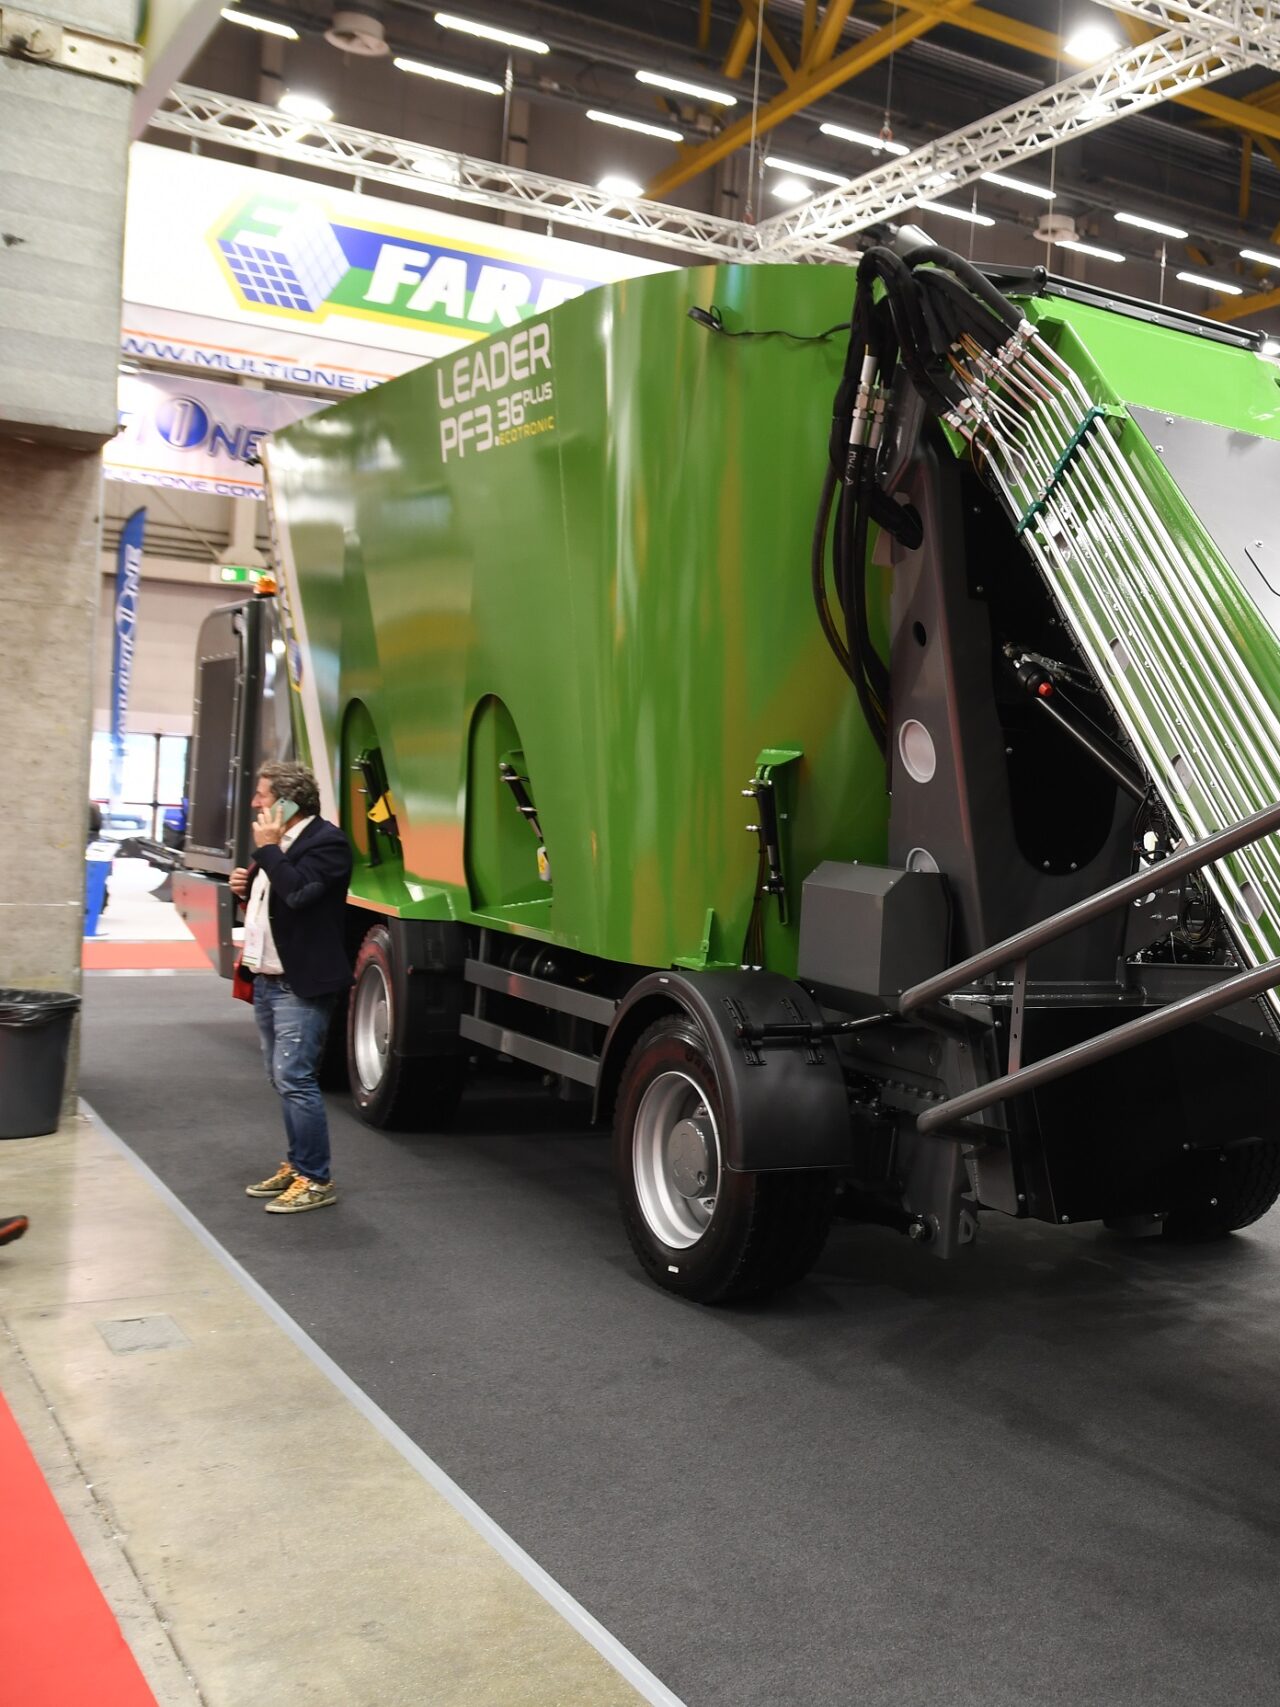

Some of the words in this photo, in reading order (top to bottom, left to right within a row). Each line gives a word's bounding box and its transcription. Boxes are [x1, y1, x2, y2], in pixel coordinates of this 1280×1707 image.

[437, 322, 552, 409] LEADER
[522, 381, 553, 407] PLUS
[499, 415, 555, 446] ECOTRONIC
